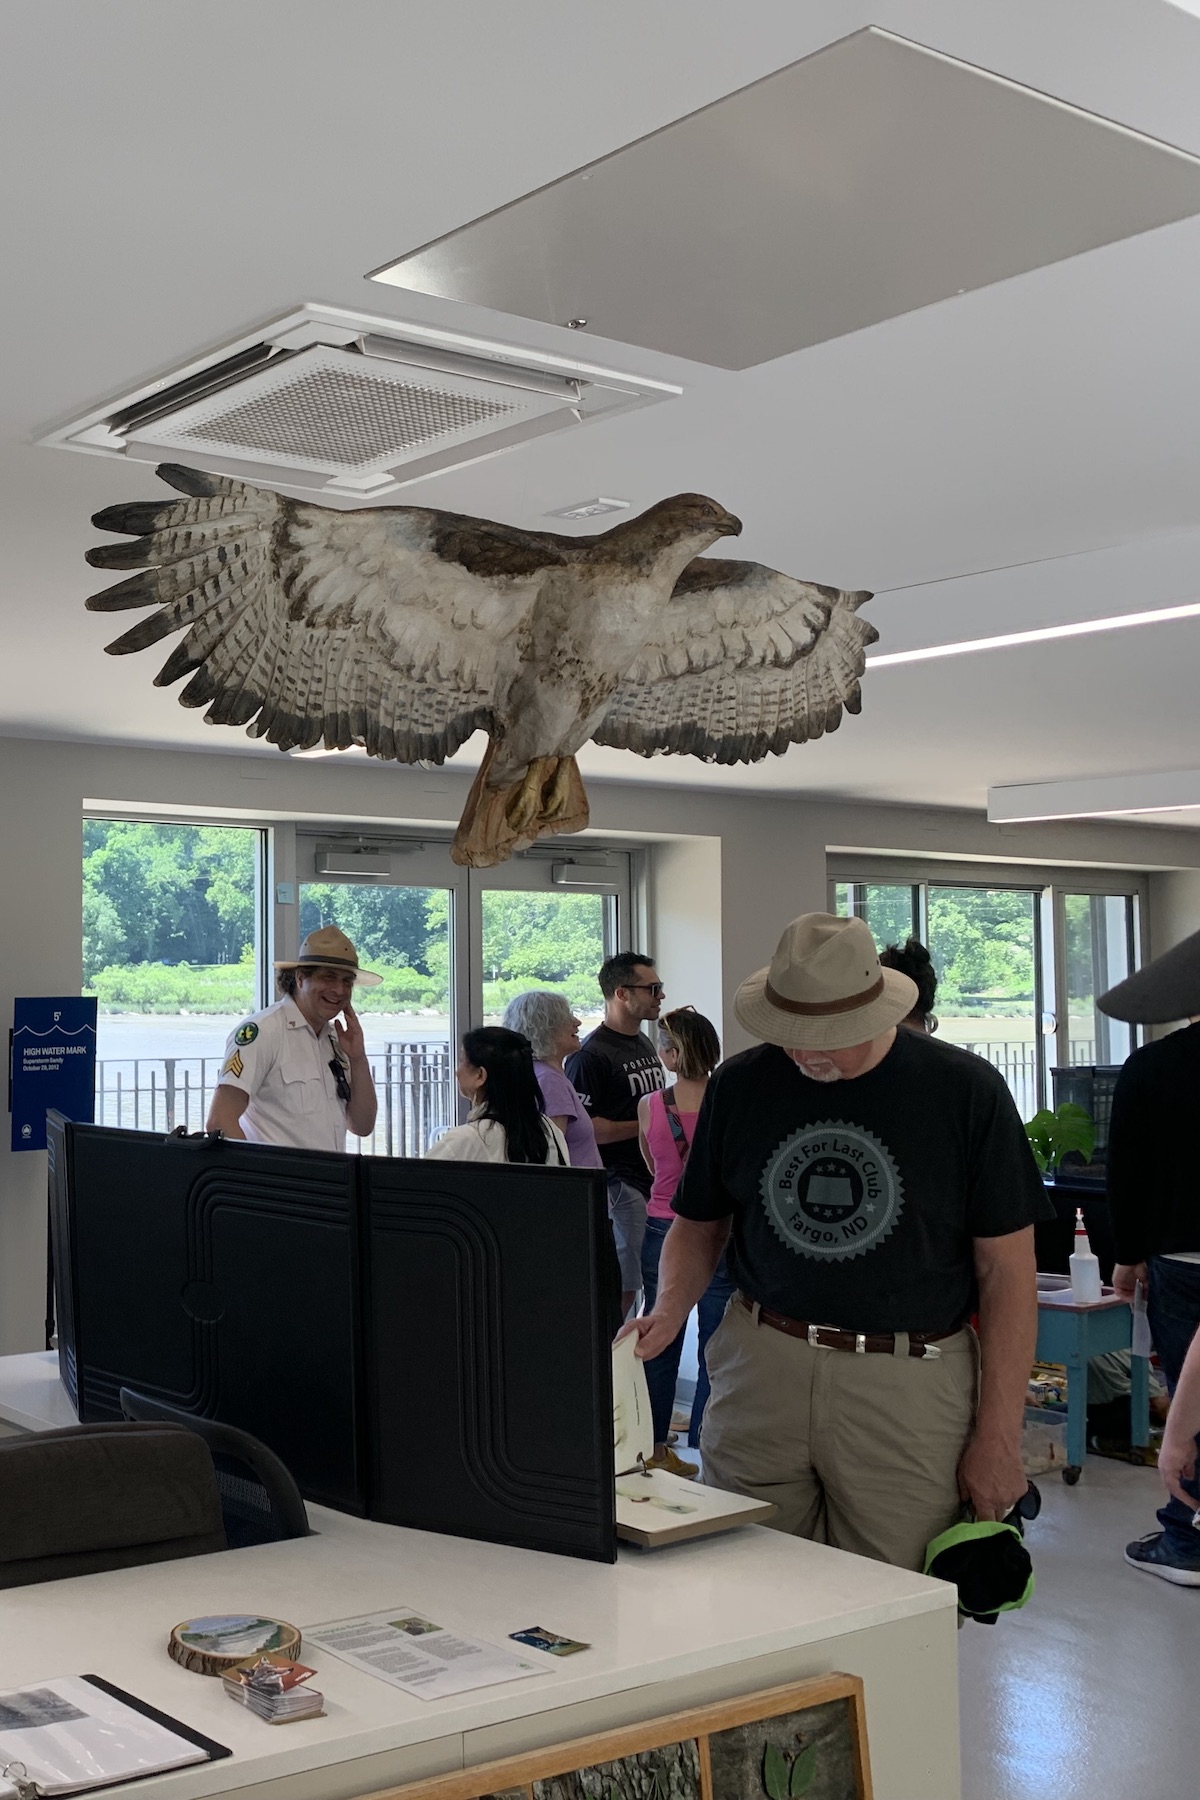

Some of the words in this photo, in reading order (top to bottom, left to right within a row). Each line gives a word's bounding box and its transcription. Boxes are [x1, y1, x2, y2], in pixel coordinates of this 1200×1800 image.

[53, 1011, 62, 1022] 5'
[23, 1047, 41, 1056] HIGH
[41, 1046, 66, 1055] WATER
[66, 1045, 87, 1054] MARK
[22, 1057, 50, 1065] Superstorm
[50, 1057, 64, 1065] Sandy
[779, 1155, 804, 1190] Best
[802, 1141, 828, 1159] For
[832, 1139, 865, 1162] Last
[862, 1161, 882, 1199] Club
[789, 1212, 839, 1244] Fargo,
[841, 1215, 869, 1240] ND
